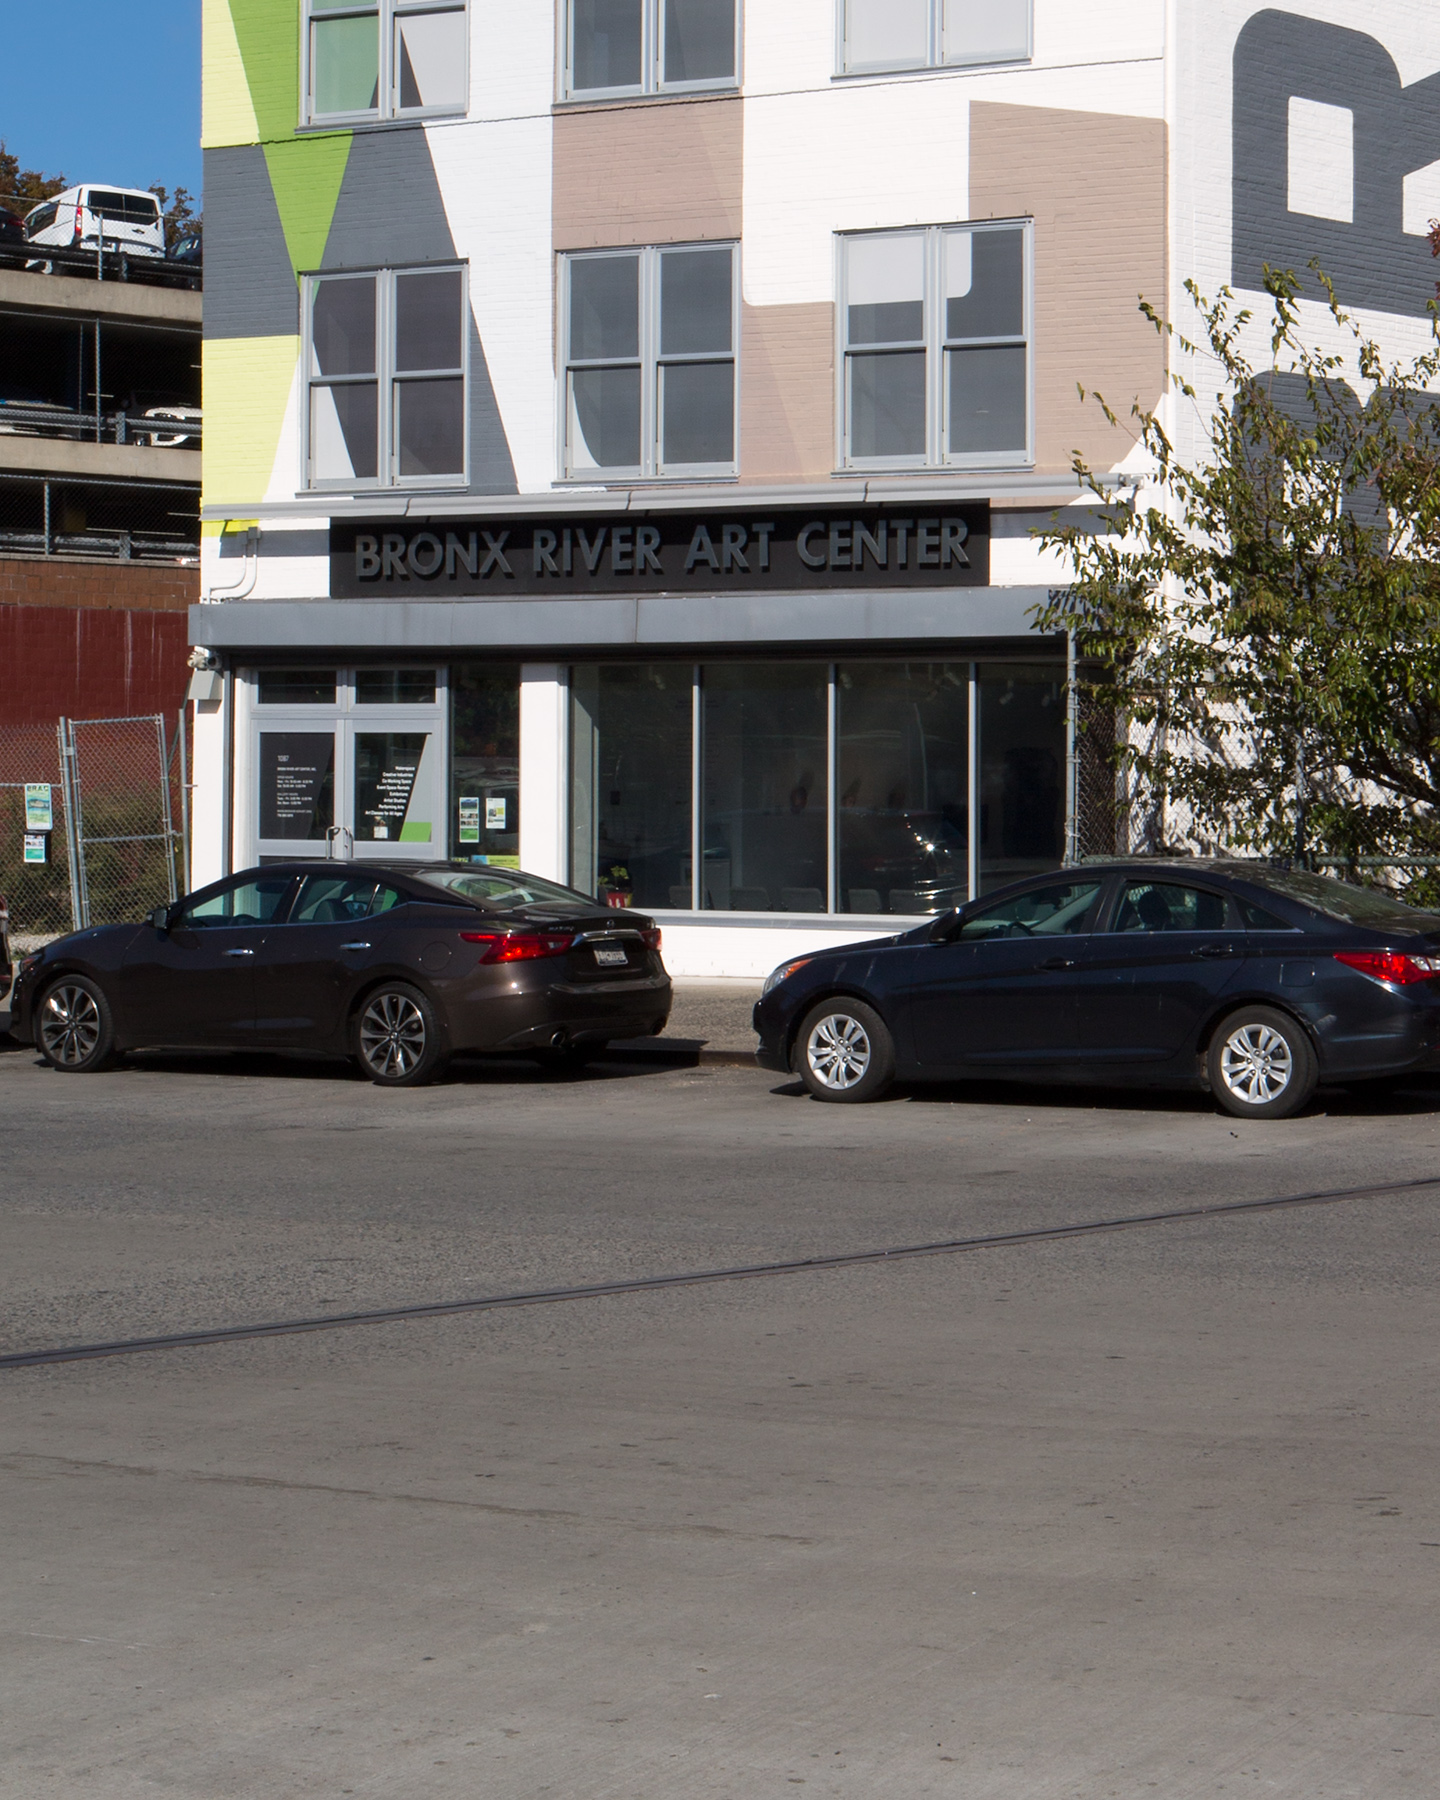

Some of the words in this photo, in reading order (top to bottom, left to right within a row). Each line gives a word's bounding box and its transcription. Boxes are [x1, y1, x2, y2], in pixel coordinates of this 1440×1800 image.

[355, 531, 514, 581] BRONX
[532, 525, 664, 578] RIVER
[683, 522, 775, 574] ART
[796, 517, 970, 572] CENTER
